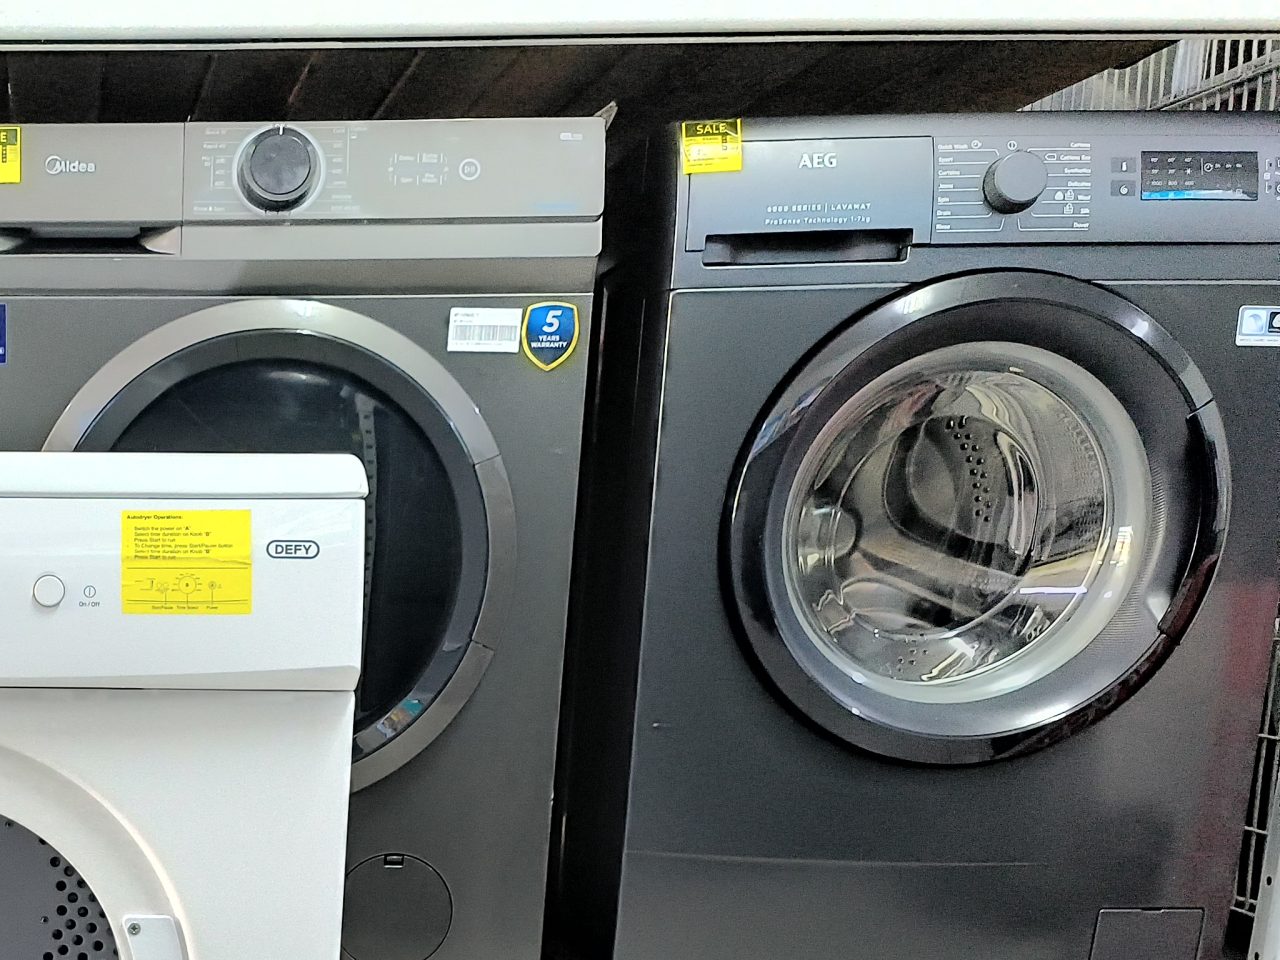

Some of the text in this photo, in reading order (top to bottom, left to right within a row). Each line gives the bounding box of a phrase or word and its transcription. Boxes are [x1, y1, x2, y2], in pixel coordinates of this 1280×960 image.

[696, 123, 727, 134] SALE
[45, 155, 96, 175] Midea
[799, 152, 837, 169] AEG
[831, 203, 871, 211] LAVAMAT
[804, 216, 848, 225] Technology
[542, 310, 562, 333] 5
[275, 545, 312, 555] DEFY
